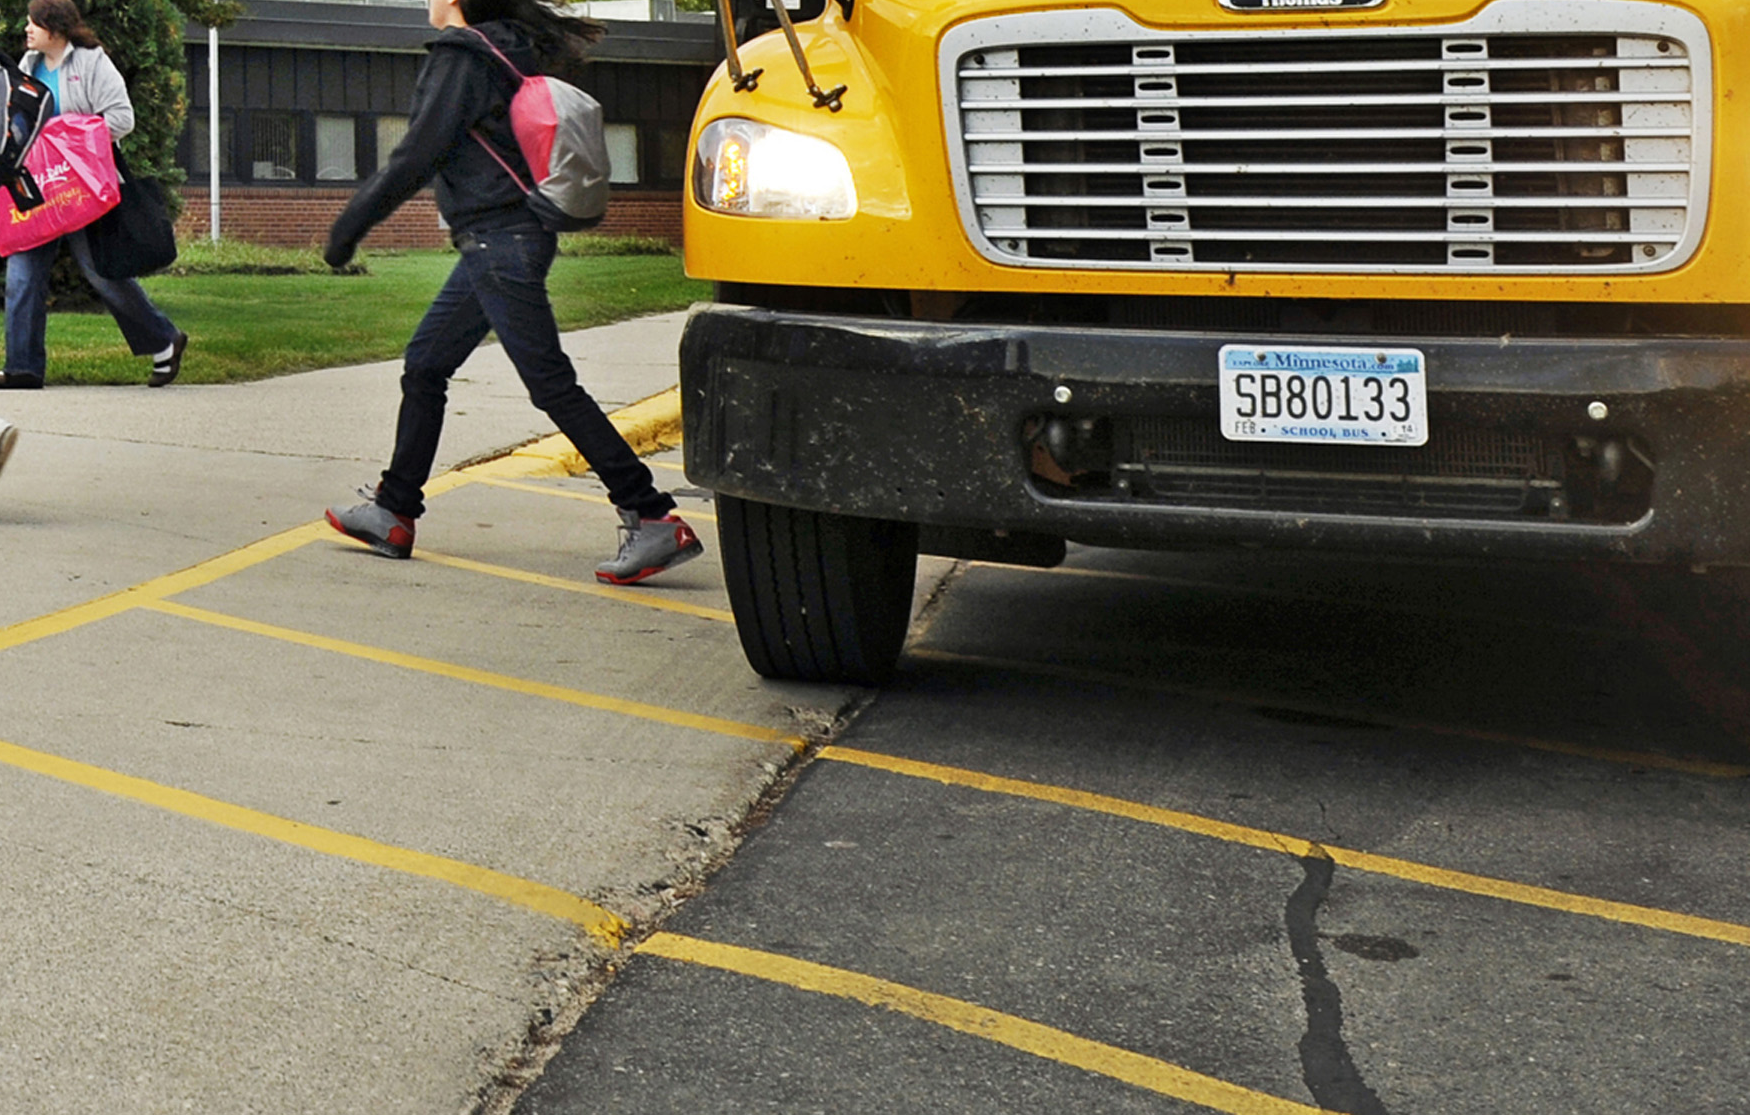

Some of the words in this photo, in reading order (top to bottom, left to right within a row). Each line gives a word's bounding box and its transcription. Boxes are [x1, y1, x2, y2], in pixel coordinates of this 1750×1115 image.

[1235, 372, 1411, 423] SB80133
[1234, 420, 1257, 435] FEB
[1280, 425, 1336, 438] SCHOOL
[1342, 427, 1369, 438] BUS
